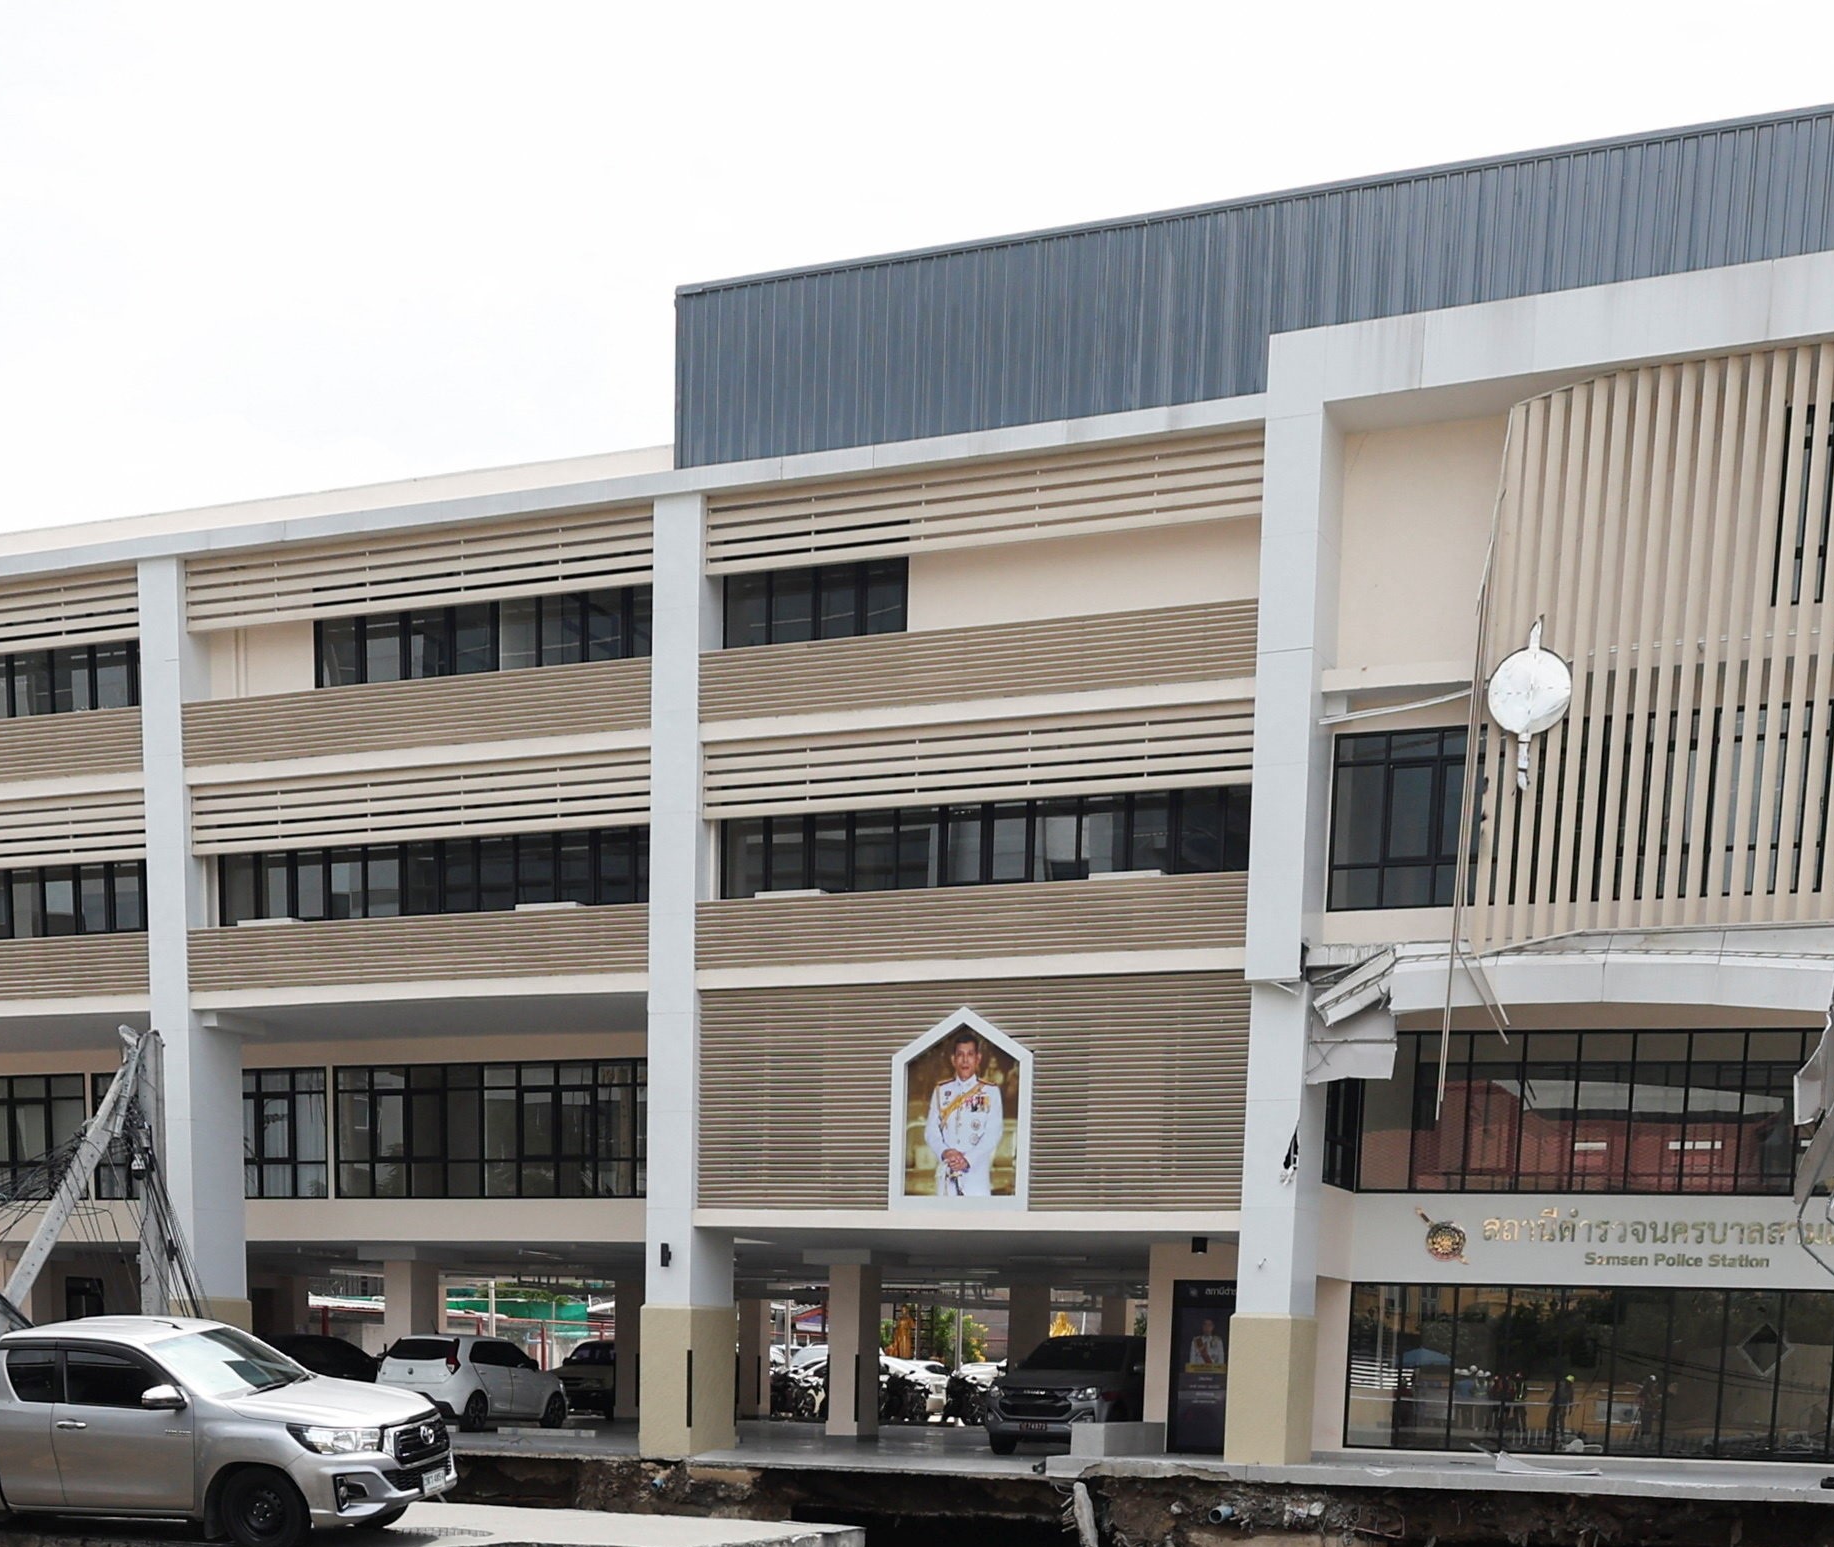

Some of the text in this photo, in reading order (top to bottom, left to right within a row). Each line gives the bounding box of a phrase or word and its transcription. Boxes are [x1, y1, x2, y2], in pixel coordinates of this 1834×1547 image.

[1584, 1252, 1770, 1269] Samsen Police Station
